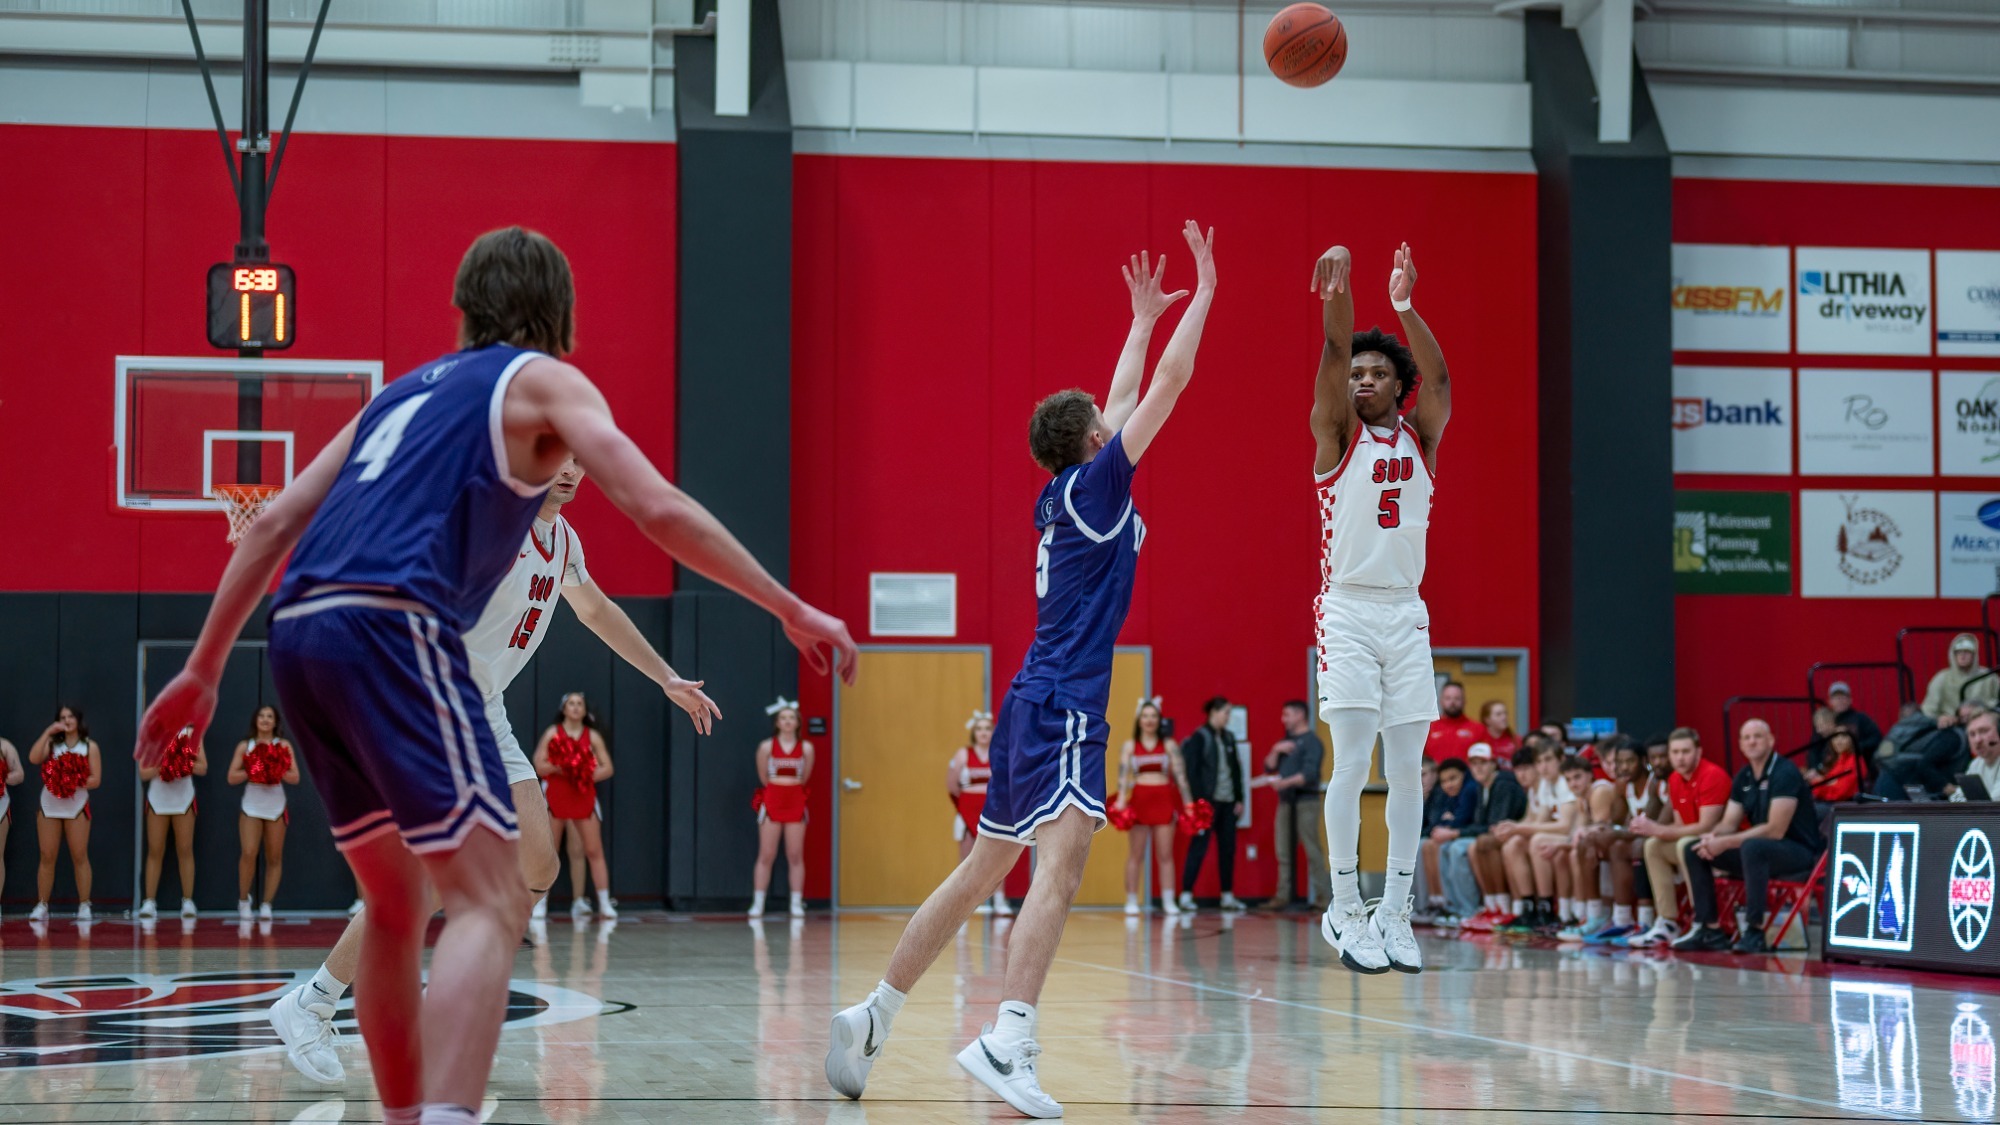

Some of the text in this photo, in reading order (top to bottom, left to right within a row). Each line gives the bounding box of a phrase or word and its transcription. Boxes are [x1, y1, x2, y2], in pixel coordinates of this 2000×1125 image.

[1824, 272, 1906, 297] LITHIA
[241, 293, 285, 341] 11
[1819, 297, 1927, 325] driveway
[1956, 398, 1998, 418] OAK
[353, 391, 433, 483] 4
[1372, 457, 1413, 484] SOU
[1377, 488, 1401, 529] 5
[1708, 513, 1772, 529] Retirement
[1708, 534, 1760, 554] Planning
[1951, 534, 2000, 552] MERC
[528, 573, 555, 602] SOU
[508, 607, 543, 650] 15
